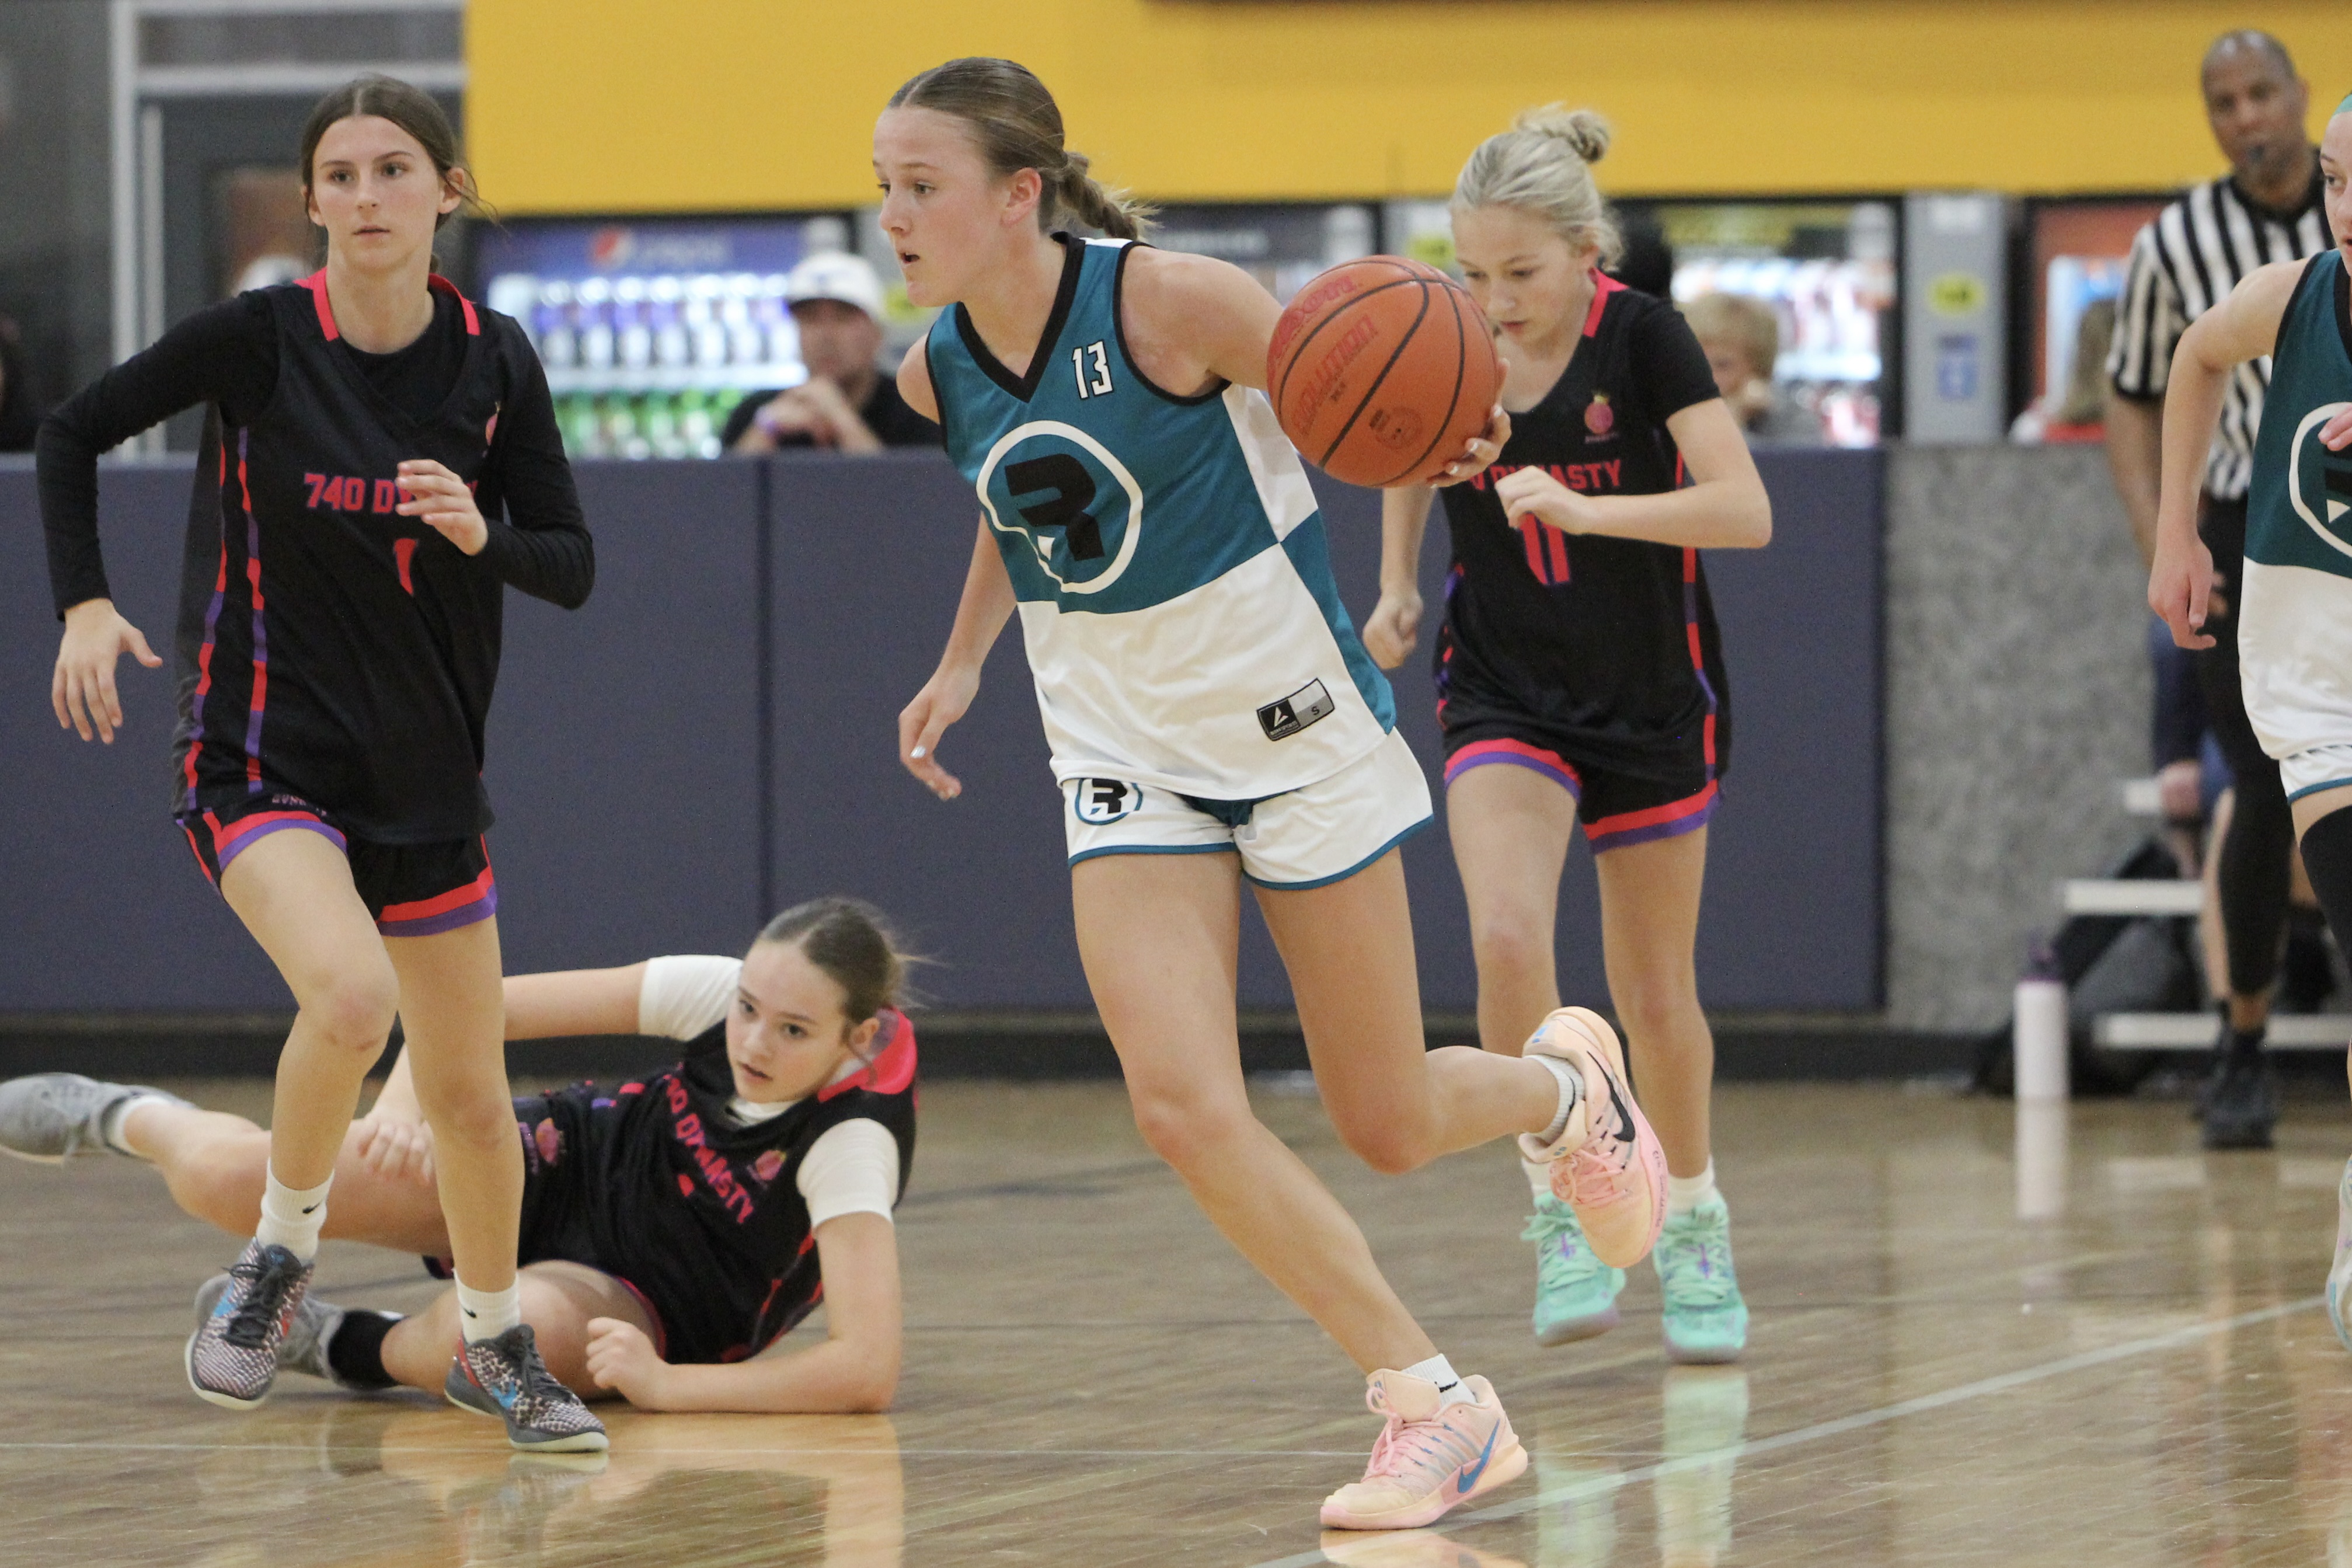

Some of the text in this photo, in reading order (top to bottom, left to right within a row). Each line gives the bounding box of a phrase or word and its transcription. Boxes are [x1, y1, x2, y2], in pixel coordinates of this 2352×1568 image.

[1072, 339, 1113, 400] 13
[1489, 459, 1621, 490] DASTY
[304, 473, 365, 511] 740
[1311, 706, 1320, 715] S
